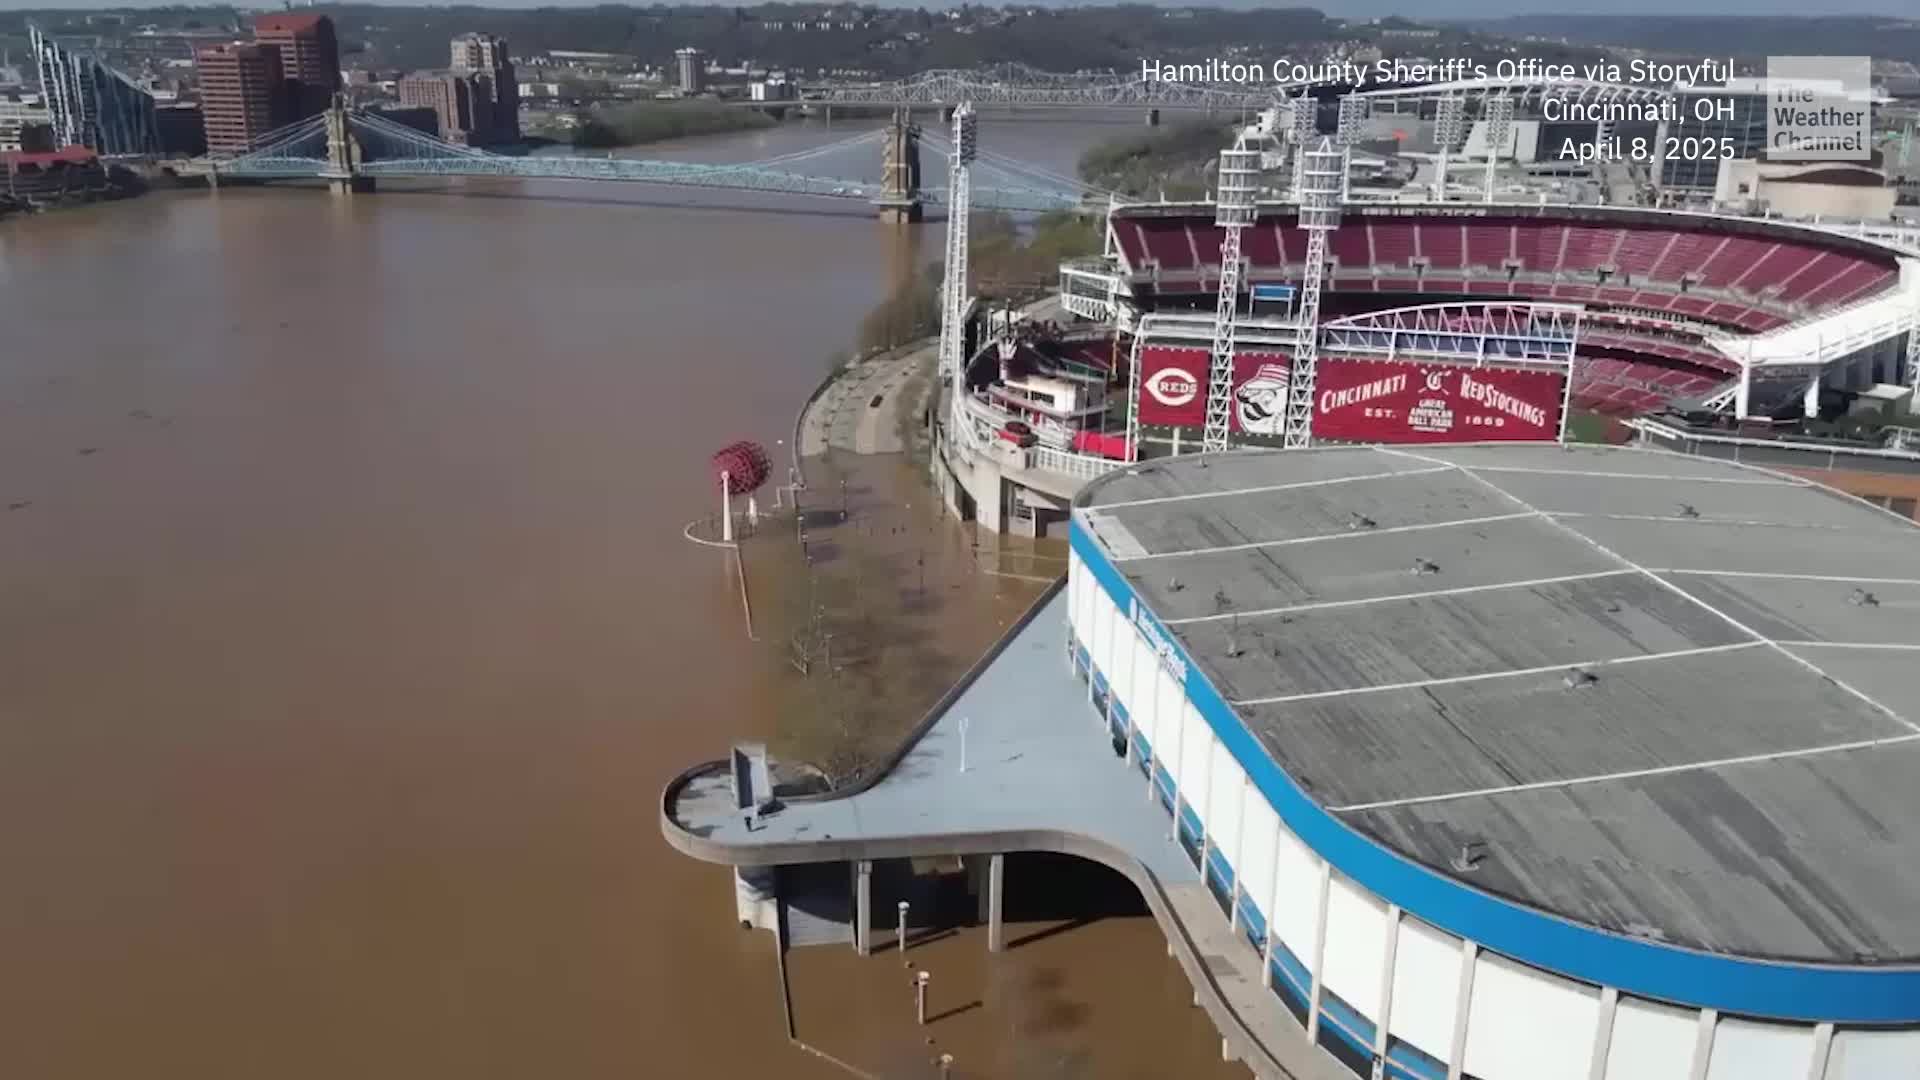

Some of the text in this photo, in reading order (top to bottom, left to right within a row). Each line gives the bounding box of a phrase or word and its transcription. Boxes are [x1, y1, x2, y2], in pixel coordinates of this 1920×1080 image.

[1160, 381, 1198, 394] REDS
[1320, 373, 1408, 415] CINCINNATI
[1364, 407, 1397, 419] EST.
